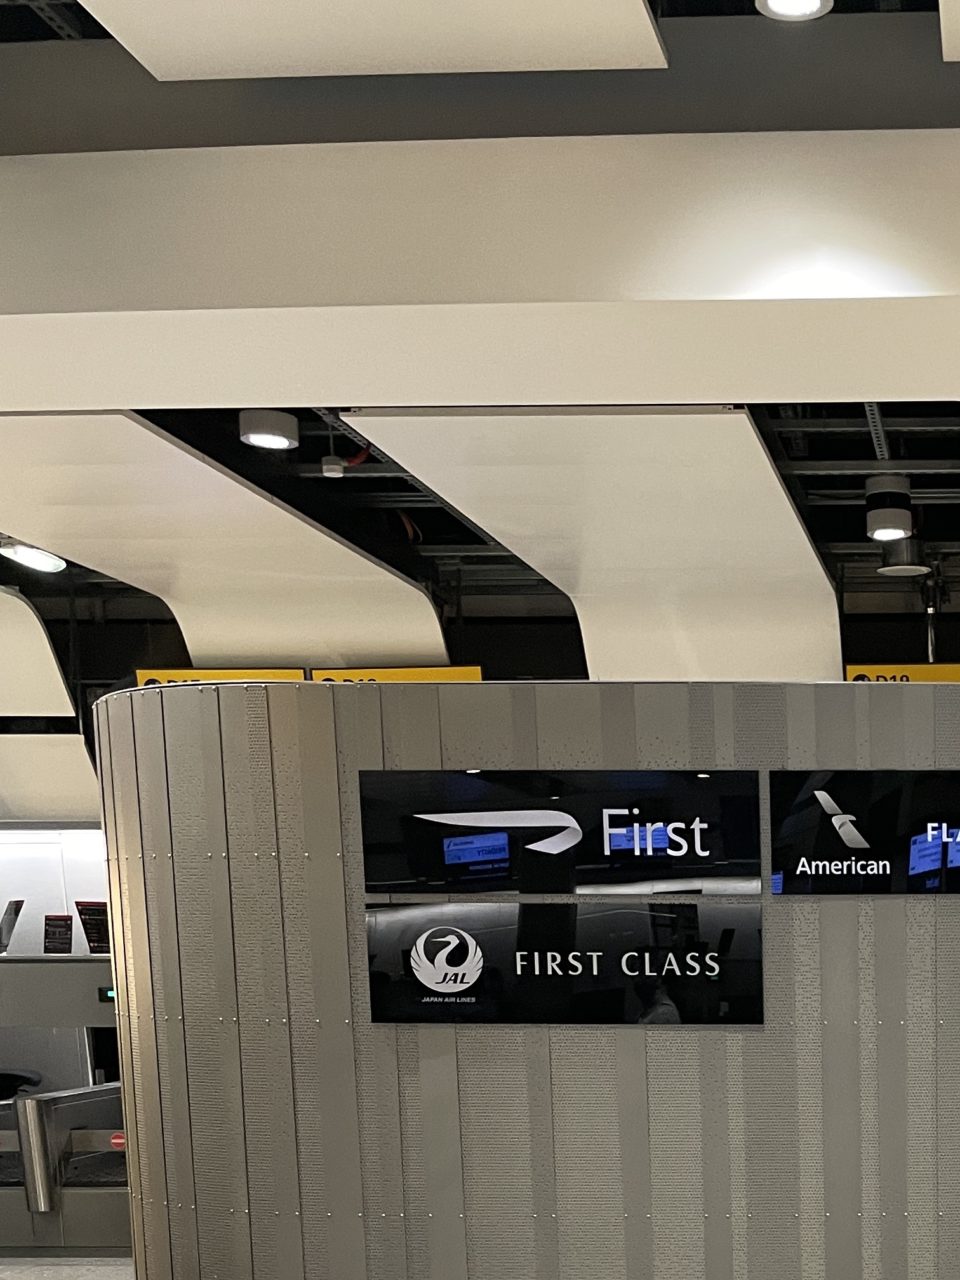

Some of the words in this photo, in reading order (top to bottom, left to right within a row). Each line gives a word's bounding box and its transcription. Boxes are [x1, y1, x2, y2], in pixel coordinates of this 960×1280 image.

[602, 808, 710, 857] First
[795, 856, 891, 875] American
[515, 951, 603, 976] FIRST
[621, 951, 720, 976] CLASS
[435, 972, 470, 984] JAL
